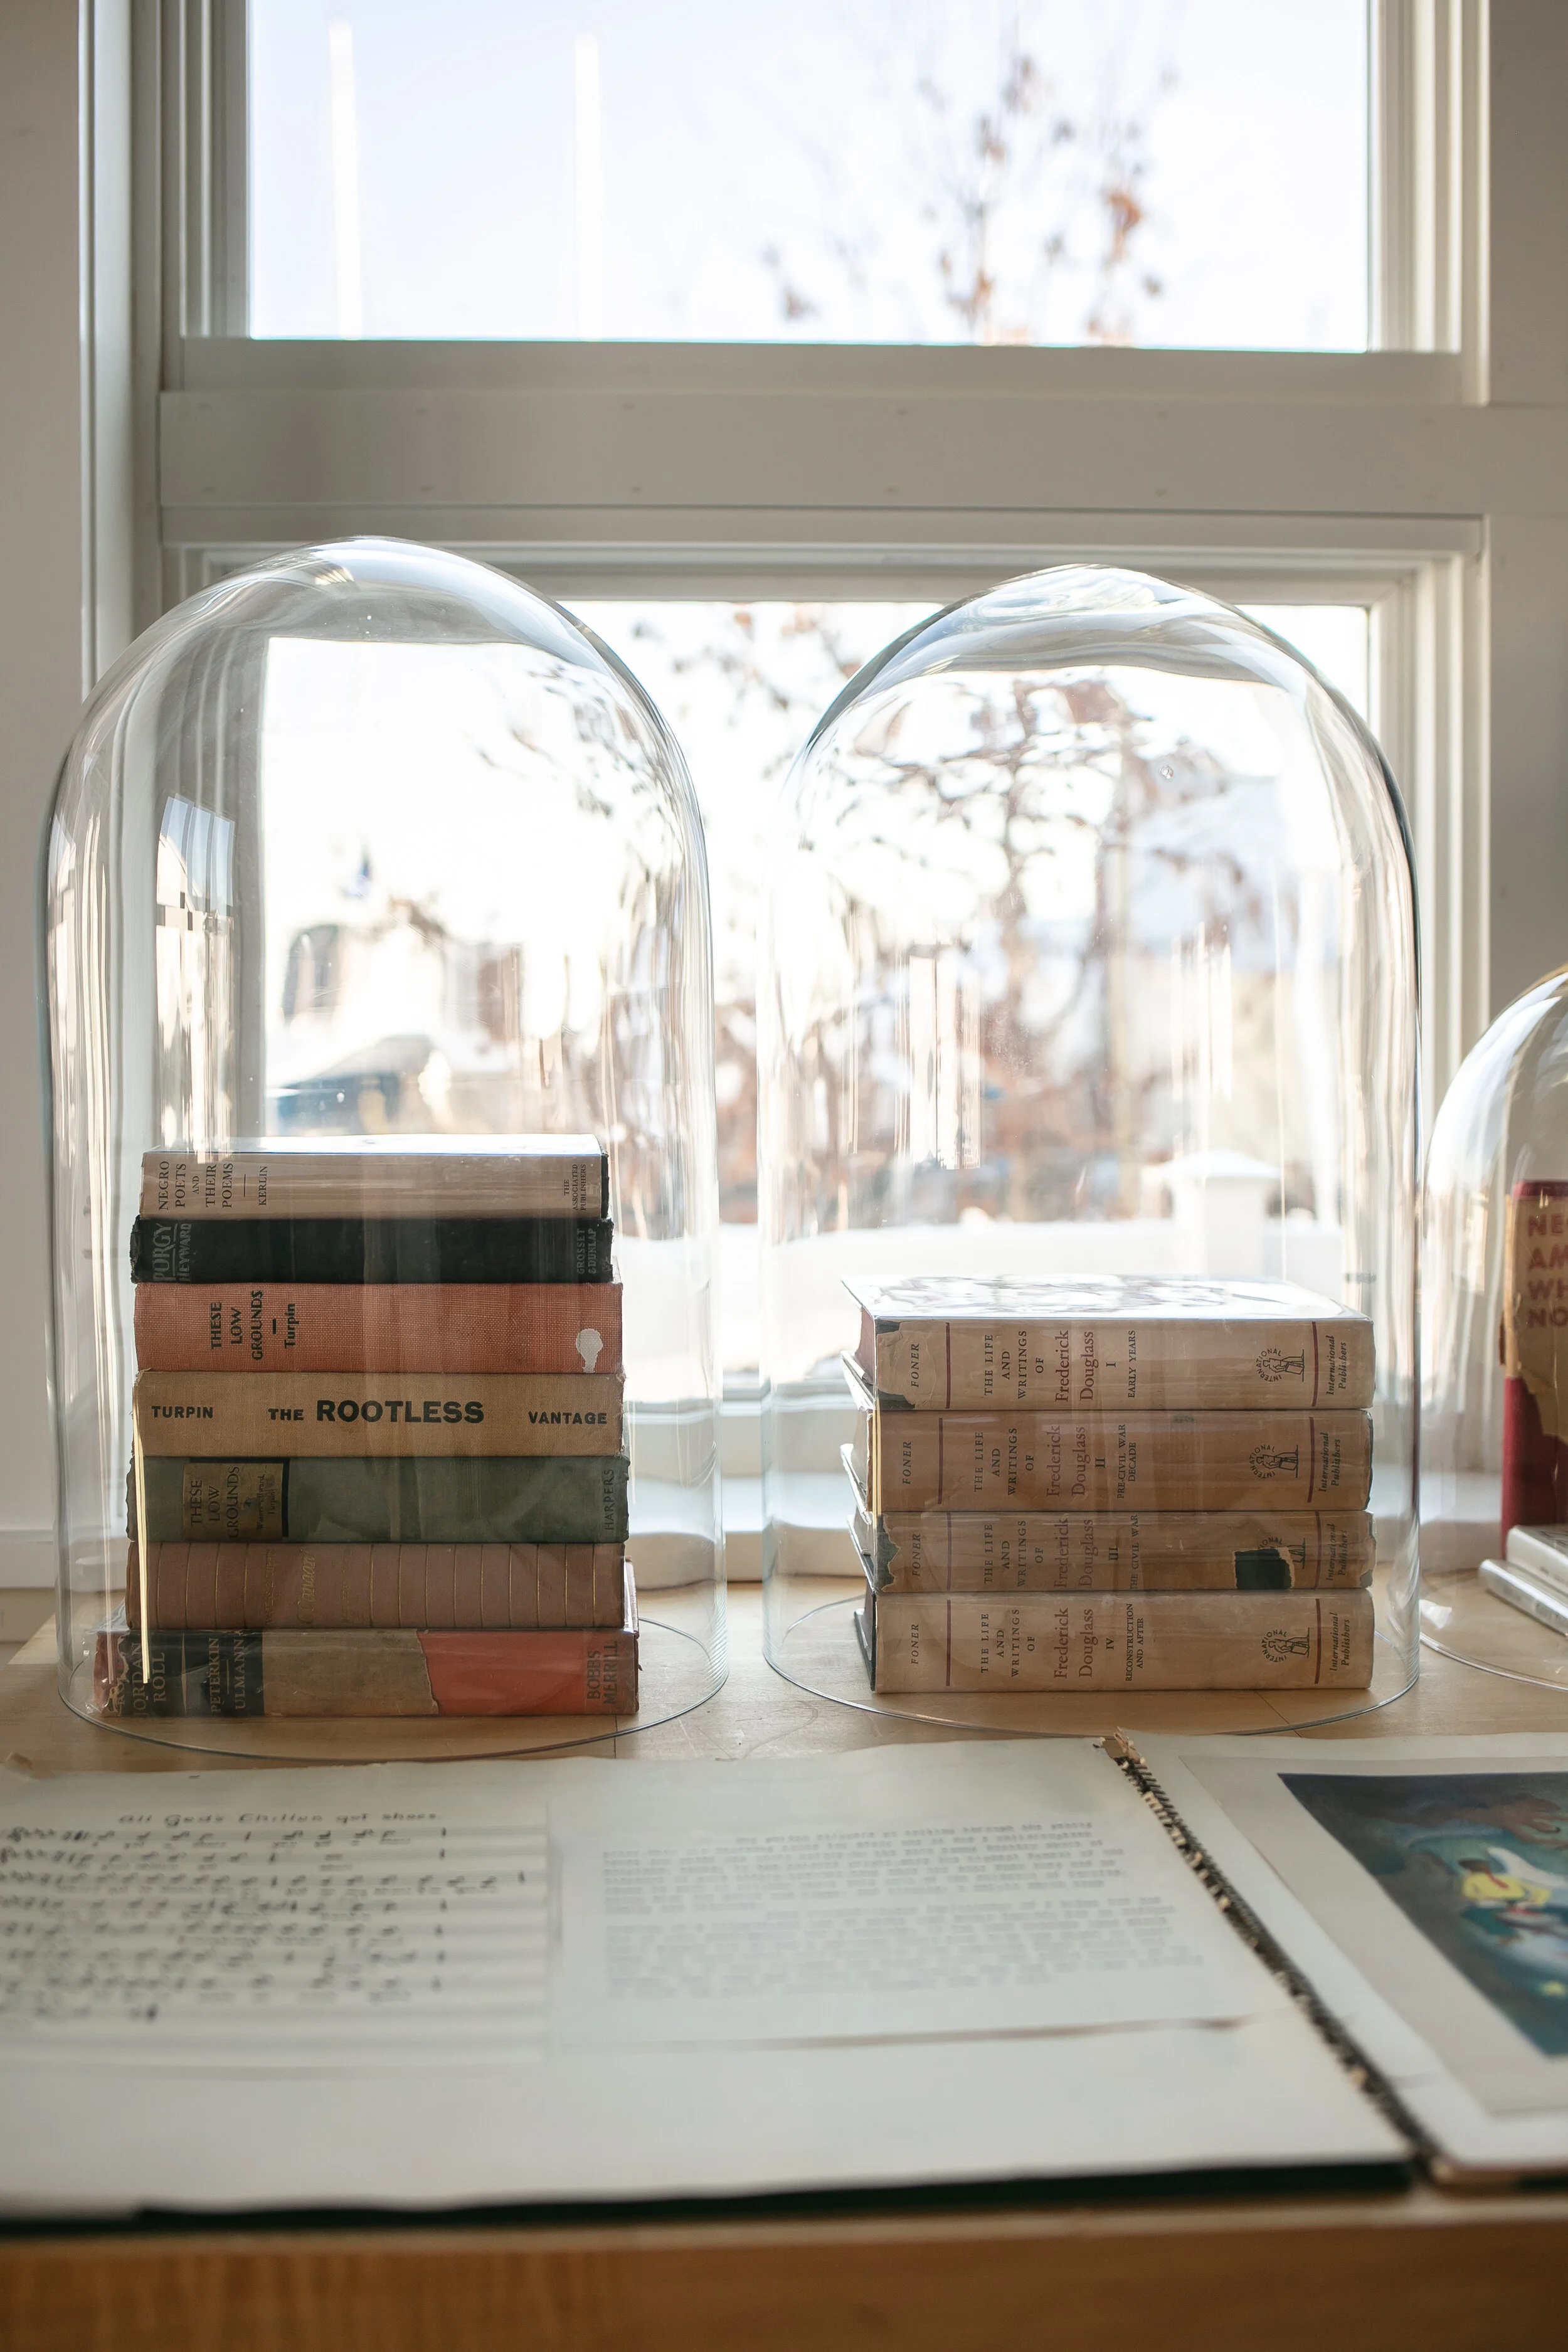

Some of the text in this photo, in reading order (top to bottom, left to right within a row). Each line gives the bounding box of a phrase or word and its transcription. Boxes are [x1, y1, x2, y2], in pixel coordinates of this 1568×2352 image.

[158, 1160, 170, 1210] NEGRO
[175, 1163, 187, 1208] POETS
[206, 1163, 217, 1208] THEIR
[222, 1162, 234, 1209] POEMS
[258, 1165, 268, 1206] KERLIN
[1527, 1214, 1568, 1236] NE
[152, 1223, 176, 1281] PORGY
[177, 1224, 192, 1281] HEYWARD
[576, 1228, 586, 1275] GROSSET
[211, 1302, 222, 1350] THESE
[231, 1308, 242, 1345] LOW
[252, 1290, 263, 1360] GROUNDS
[284, 1303, 299, 1348] Turpin
[911, 1342, 920, 1388] FONER
[984, 1334, 994, 1396] THE LIFE
[1002, 1350, 1010, 1380] AND
[1017, 1330, 1027, 1400] WRITINGS
[1035, 1357, 1044, 1374] OF
[1054, 1330, 1069, 1402] Frederick
[1079, 1330, 1099, 1401] Douglass
[1128, 1330, 1136, 1399] EARLY YEARS
[1256, 1347, 1283, 1382] INTERNATIONAL
[1325, 1335, 1335, 1396] International
[1337, 1341, 1347, 1390] Publishers
[151, 1399, 608, 1424] TURPIN THE ROOTLESS VANTAGE
[902, 1441, 912, 1485] FONER
[974, 1431, 983, 1493] THE LIFE
[992, 1448, 1000, 1477] AND
[1007, 1428, 1017, 1496] WRITINGS
[1025, 1454, 1034, 1471] OF
[1046, 1425, 1061, 1498] Frederick
[1071, 1426, 1091, 1496] Douglass
[1095, 1457, 1106, 1468] II
[1128, 1441, 1136, 1482] DECADE
[1248, 1444, 1276, 1480] INTERNATIONAL
[1318, 1432, 1329, 1493] International
[1330, 1438, 1341, 1486] Publishers
[190, 1479, 203, 1527] THESE
[207, 1485, 221, 1522] LOW
[226, 1466, 240, 1539] GROUNDS
[604, 1468, 615, 1531] HARPERS
[911, 1532, 921, 1577] FONER
[984, 1523, 993, 1584] THE LIFE
[1002, 1540, 1010, 1569] AND
[1017, 1520, 1027, 1587] WRITINGS
[1035, 1547, 1044, 1564] OF
[1054, 1516, 1069, 1589] Frederick
[1079, 1518, 1098, 1589] Douglass
[1130, 1514, 1140, 1590] THE CIVIL WAR
[1325, 1523, 1336, 1581] International
[1337, 1530, 1348, 1576] Publishers
[911, 1623, 920, 1665] FONER
[981, 1644, 989, 1673] THE
[1011, 1609, 1020, 1677] WRITINGS
[1027, 1636, 1036, 1651] OF
[1054, 1607, 1069, 1679] Frederick
[1078, 1608, 1098, 1678] Douglass
[1106, 1637, 1115, 1650] IV
[1261, 1629, 1288, 1663] INTERNATIONAL
[1329, 1611, 1340, 1671] International
[1340, 1618, 1350, 1666] Publishers
[152, 1652, 167, 1703] ROLL
[209, 1638, 221, 1713] PETERKIN
[234, 1638, 246, 1710] ULMANN
[586, 1650, 601, 1700] BOBBS
[603, 1640, 619, 1705] MERRILL
